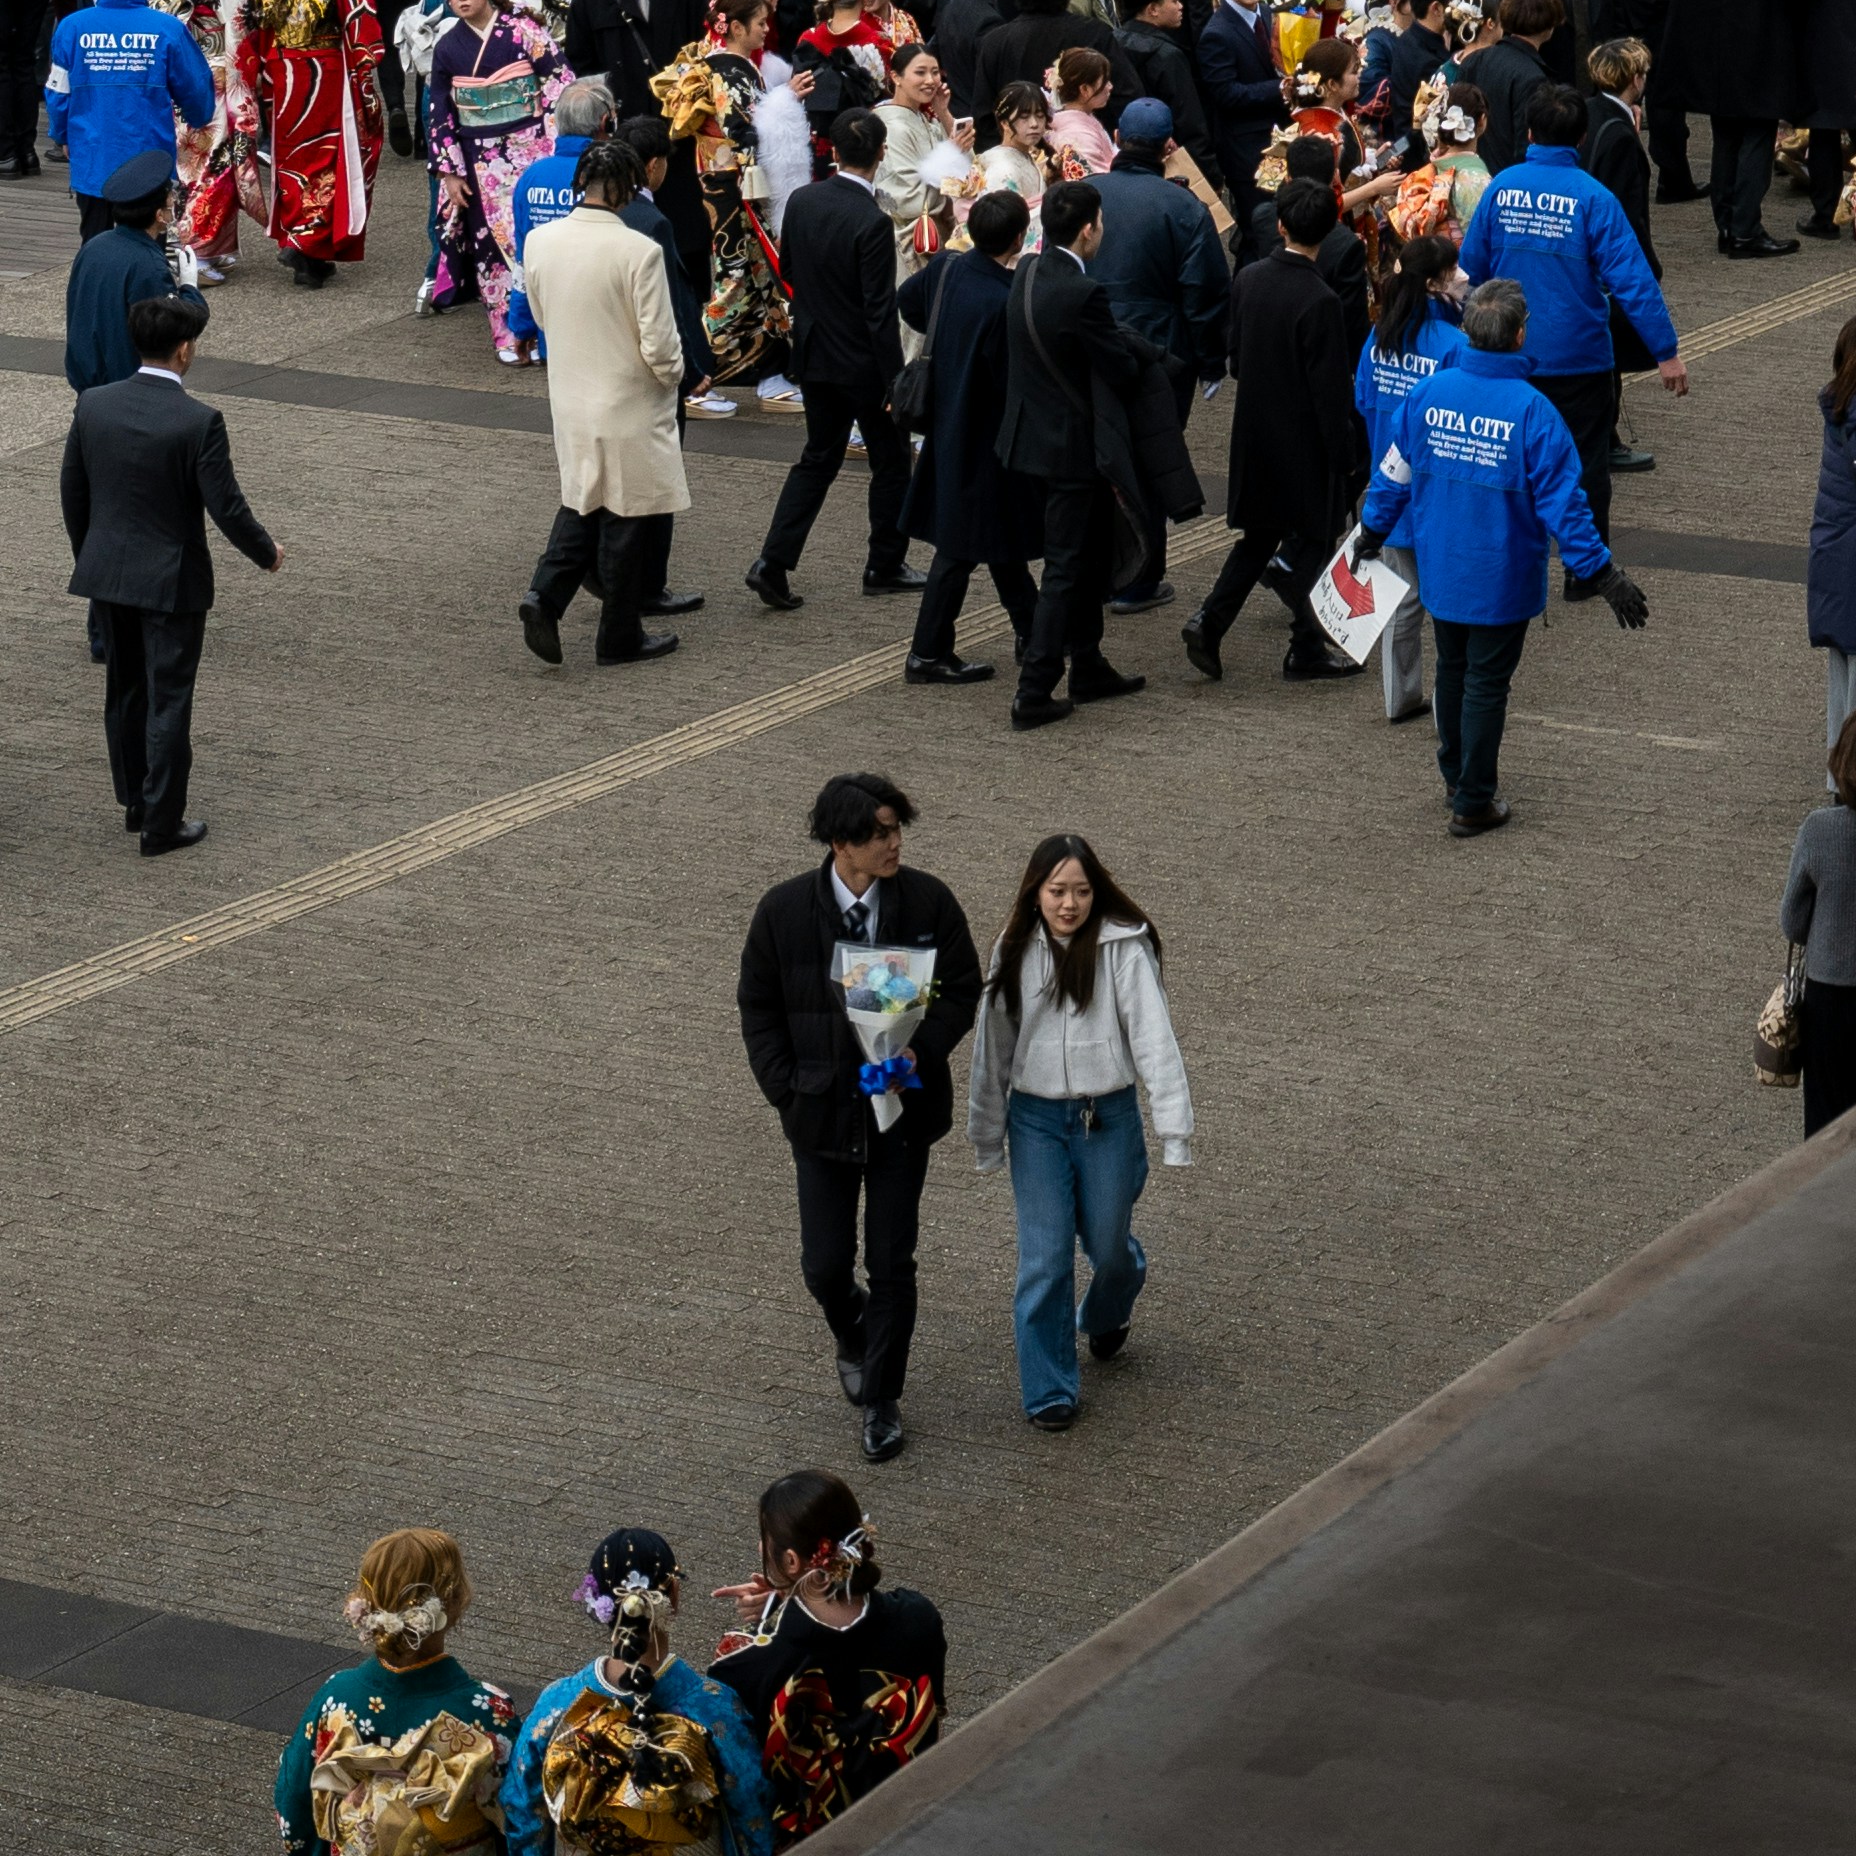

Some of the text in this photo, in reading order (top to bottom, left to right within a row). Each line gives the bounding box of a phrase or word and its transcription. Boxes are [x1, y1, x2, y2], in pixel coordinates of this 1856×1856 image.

[80, 33, 159, 49] OITA CITY
[527, 187, 555, 205] OITA
[1497, 189, 1578, 216] OITA CITY
[1402, 353, 1439, 377] CITY
[1425, 407, 1515, 441] OITA CITY
